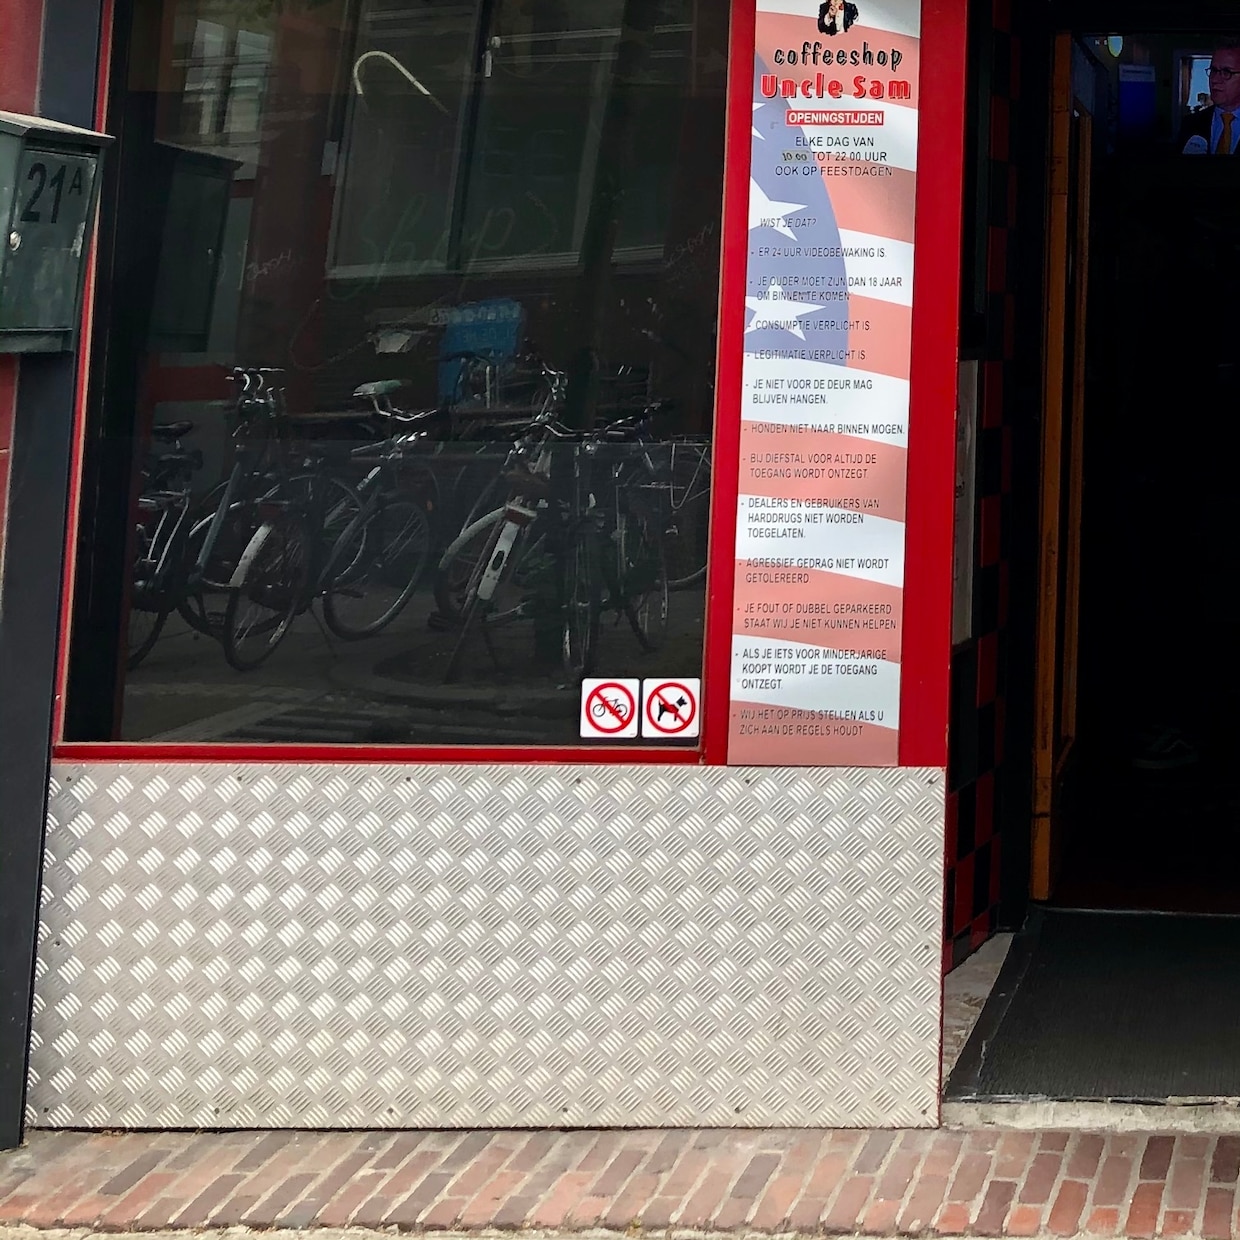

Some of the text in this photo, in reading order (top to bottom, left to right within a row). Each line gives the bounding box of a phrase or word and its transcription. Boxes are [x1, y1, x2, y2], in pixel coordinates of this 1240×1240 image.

[774, 41, 902, 72] coffeeshop
[761, 73, 911, 99] Uncle Sam
[788, 112, 884, 124] OPENINGSTIJDEN
[795, 137, 874, 147] ELKE DAG VAN
[812, 151, 834, 161] TOT
[864, 151, 887, 161] UUR
[775, 166, 892, 176] OOK OP FEESTDAGEN
[760, 218, 817, 228] WIST JE DAT?
[758, 247, 769, 257] ER
[783, 247, 802, 257] UUR
[803, 247, 875, 258] VIDEOBEWAKING
[757, 276, 903, 287] JE OUDER MOET ZIJN DAN 18 JAAR
[757, 291, 770, 301] OM
[772, 291, 804, 301] BINNEN
[806, 291, 817, 301] TE
[755, 320, 810, 331] CONSUMPTIE
[812, 320, 860, 331] VERPLICHT
[754, 349, 806, 360] LEGITIMATIE
[808, 349, 856, 360] VERPLICHT
[752, 379, 873, 390] JE NIET VOOR DE DEUR MAG
[752, 394, 787, 404] BLIJVEN
[751, 423, 787, 433] HONDEN
[789, 423, 808, 433] NIET
[811, 423, 835, 433] NAAR
[837, 424, 870, 434] BINNEN
[750, 453, 877, 464] BIJ DIEFSTAL VOOR ALTIJD DE
[750, 468, 791, 479] TOEGANG
[793, 468, 825, 479] WORDT
[748, 497, 880, 509] DEALERS EN GEBRUIKERS VAN
[748, 513, 864, 523] HARDDRUGS NIET WORDEN
[746, 558, 889, 569] AGRESSIEF GEDRAG NIET WORDT
[744, 603, 892, 614] JE FOUT OF DUBBEL GEPARKEERD
[744, 618, 896, 629] STAAT WIJ JE NIET KUNNEN HELPEN
[742, 648, 887, 660] ALS JE IETS VOOR MINDERJARIGE
[742, 664, 878, 675] KOOPT WORDT JE DE TOEGANG
[741, 709, 884, 721] WIJ HET OP PRIJS STELLEN ALS U
[739, 724, 863, 736] ZICH AAN DE REGELS HOUDT
